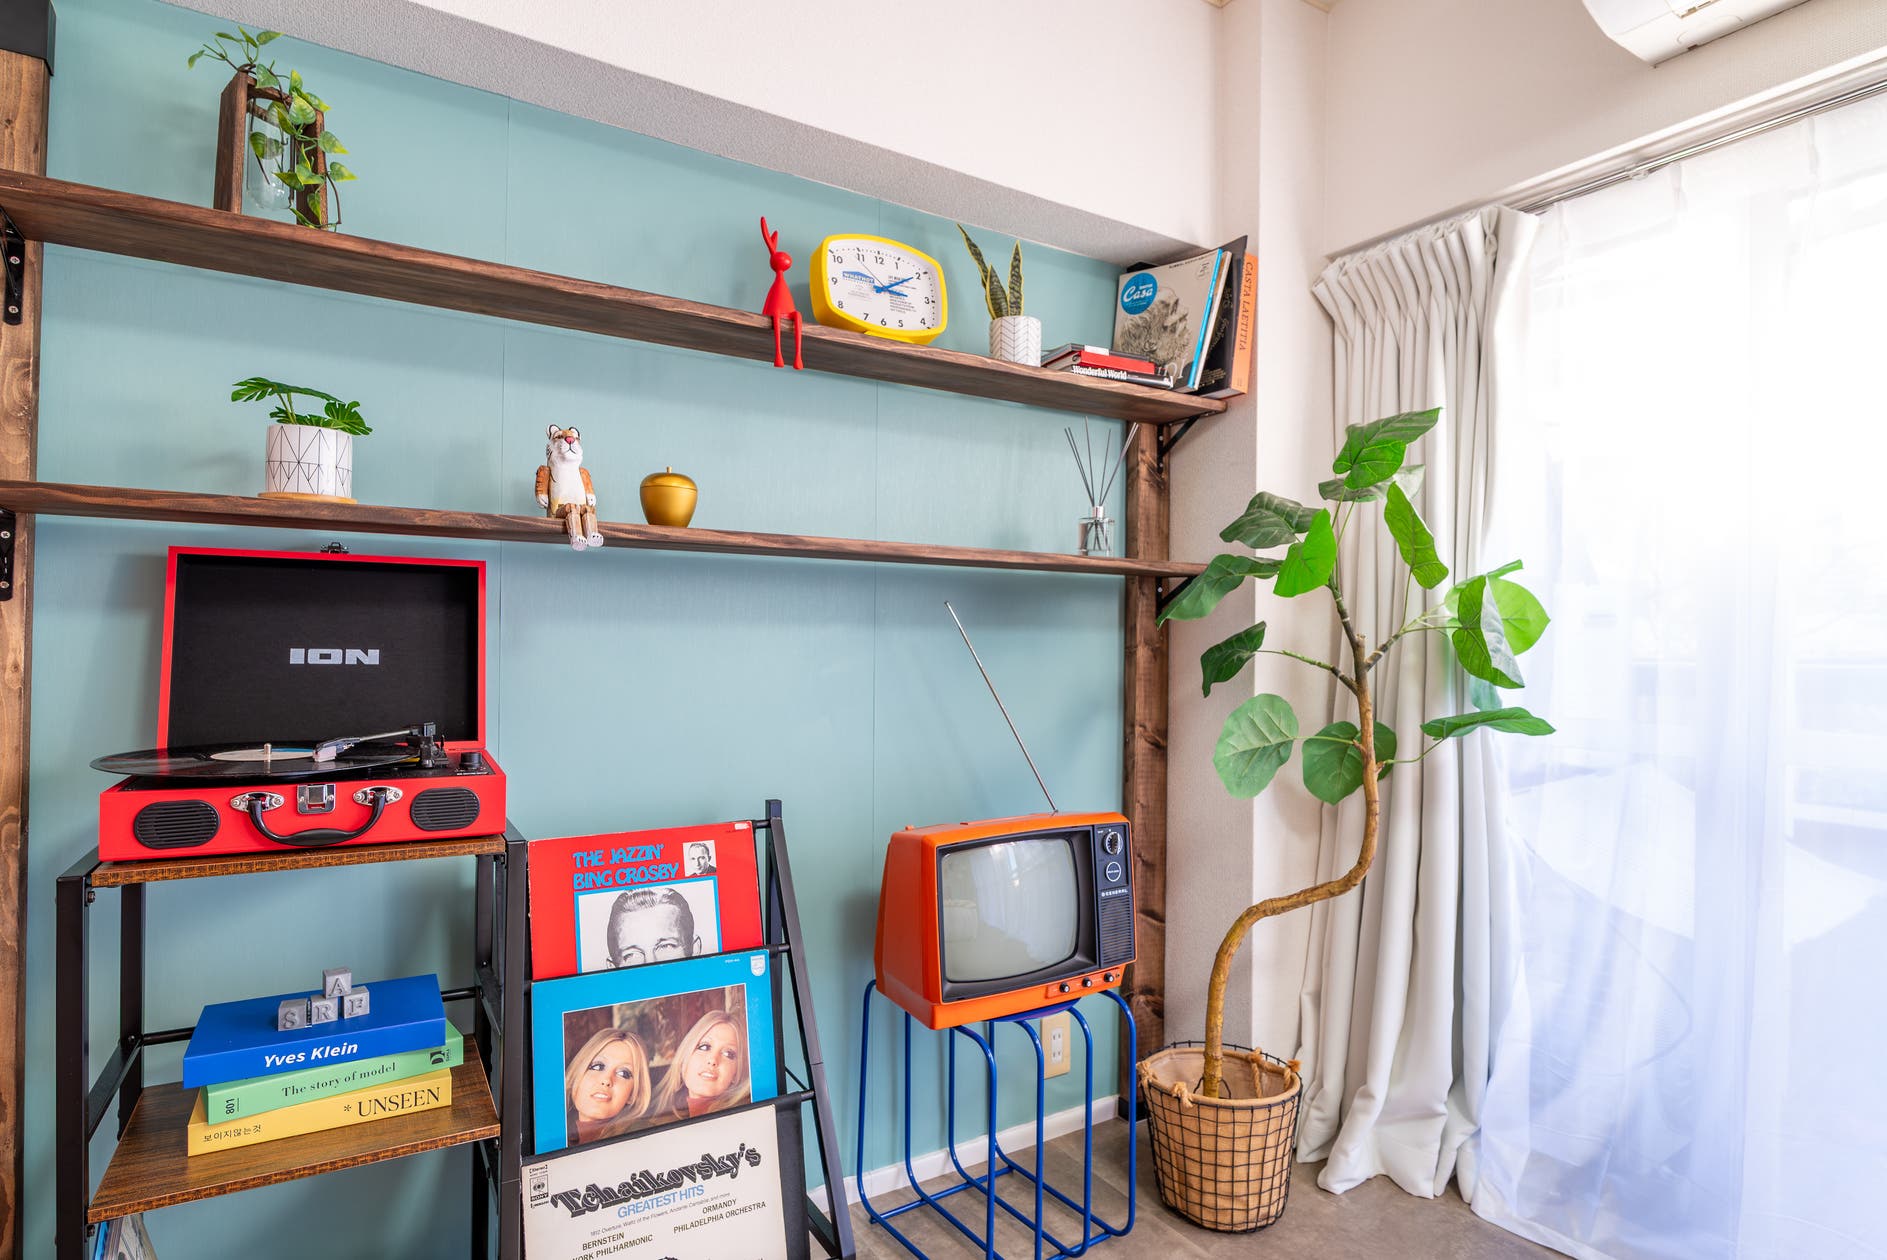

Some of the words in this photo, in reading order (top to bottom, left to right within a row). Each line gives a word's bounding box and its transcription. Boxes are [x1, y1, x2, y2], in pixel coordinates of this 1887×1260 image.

[832, 254, 843, 264] 10
[856, 253, 865, 262] 11
[874, 256, 884, 265] 12
[831, 276, 838, 285] 9
[1243, 262, 1254, 297] CASTA
[924, 296, 930, 304] 3
[1123, 285, 1153, 302] Casa
[837, 300, 844, 309] 8
[863, 313, 869, 321] 7
[880, 318, 887, 326] 6
[898, 320, 904, 328] 5
[920, 318, 927, 326] 4
[1072, 364, 1108, 378] Wonderful
[1108, 368, 1127, 380] World
[290, 648, 380, 665] ION
[572, 849, 605, 868] THE
[573, 869, 613, 890] BING
[615, 862, 679, 885] CROSBY
[328, 977, 348, 997] A
[264, 1051, 306, 1068] Yves
[310, 1042, 358, 1061] Klein
[282, 1086, 307, 1097] The
[310, 1077, 340, 1091] story
[344, 1071, 358, 1083] of
[359, 1062, 396, 1079] model
[225, 1098, 235, 1115] 801
[357, 1087, 441, 1117] UNSEEN
[551, 1143, 762, 1218] Tchaikovsky's
[617, 1191, 678, 1218] GREATEST
[680, 1184, 704, 1201] HITS
[702, 1198, 737, 1214] ORMANDY
[673, 1213, 724, 1234] PHILADELPHIA
[725, 1200, 767, 1219] ORCHESTRA
[582, 1232, 625, 1251] BERNSTEIN
[596, 1234, 654, 1258] PHILHARMONIC
